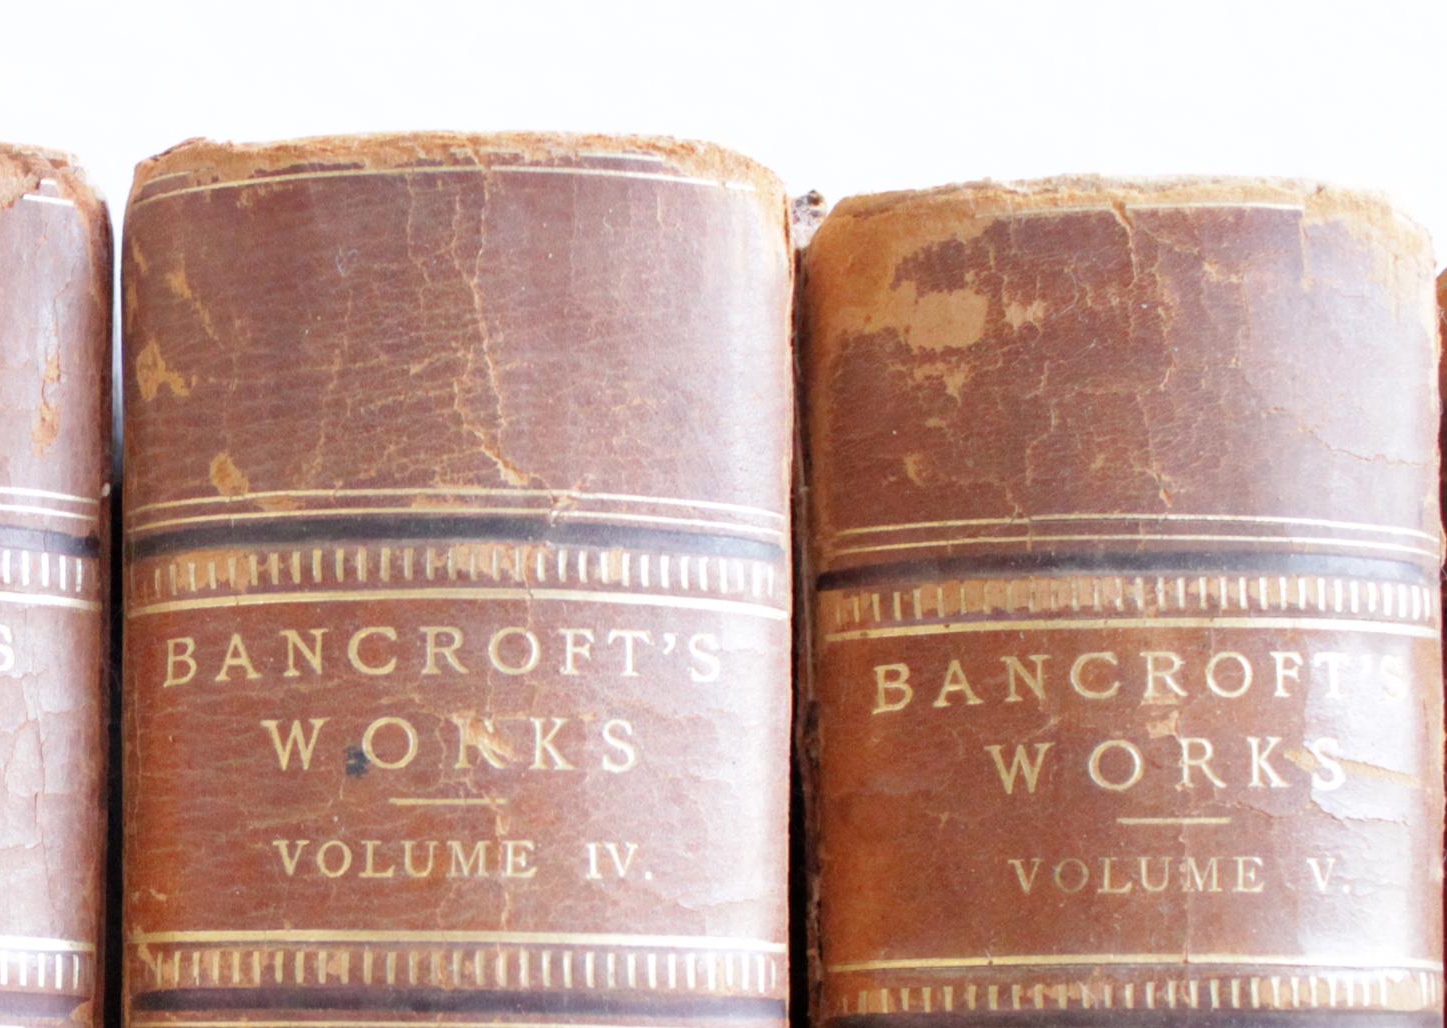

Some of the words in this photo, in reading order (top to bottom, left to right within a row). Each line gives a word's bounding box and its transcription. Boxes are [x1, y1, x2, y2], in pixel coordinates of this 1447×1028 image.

[163, 626, 722, 689] BANCROFT'S
[871, 650, 1408, 715] BANCROFT'S
[261, 716, 639, 774] WORKS
[985, 736, 1347, 795] WORKS
[273, 839, 537, 879] VOLUME
[587, 842, 652, 881] IV.
[1008, 856, 1264, 896] VOLUME
[1306, 857, 1351, 894] V.
